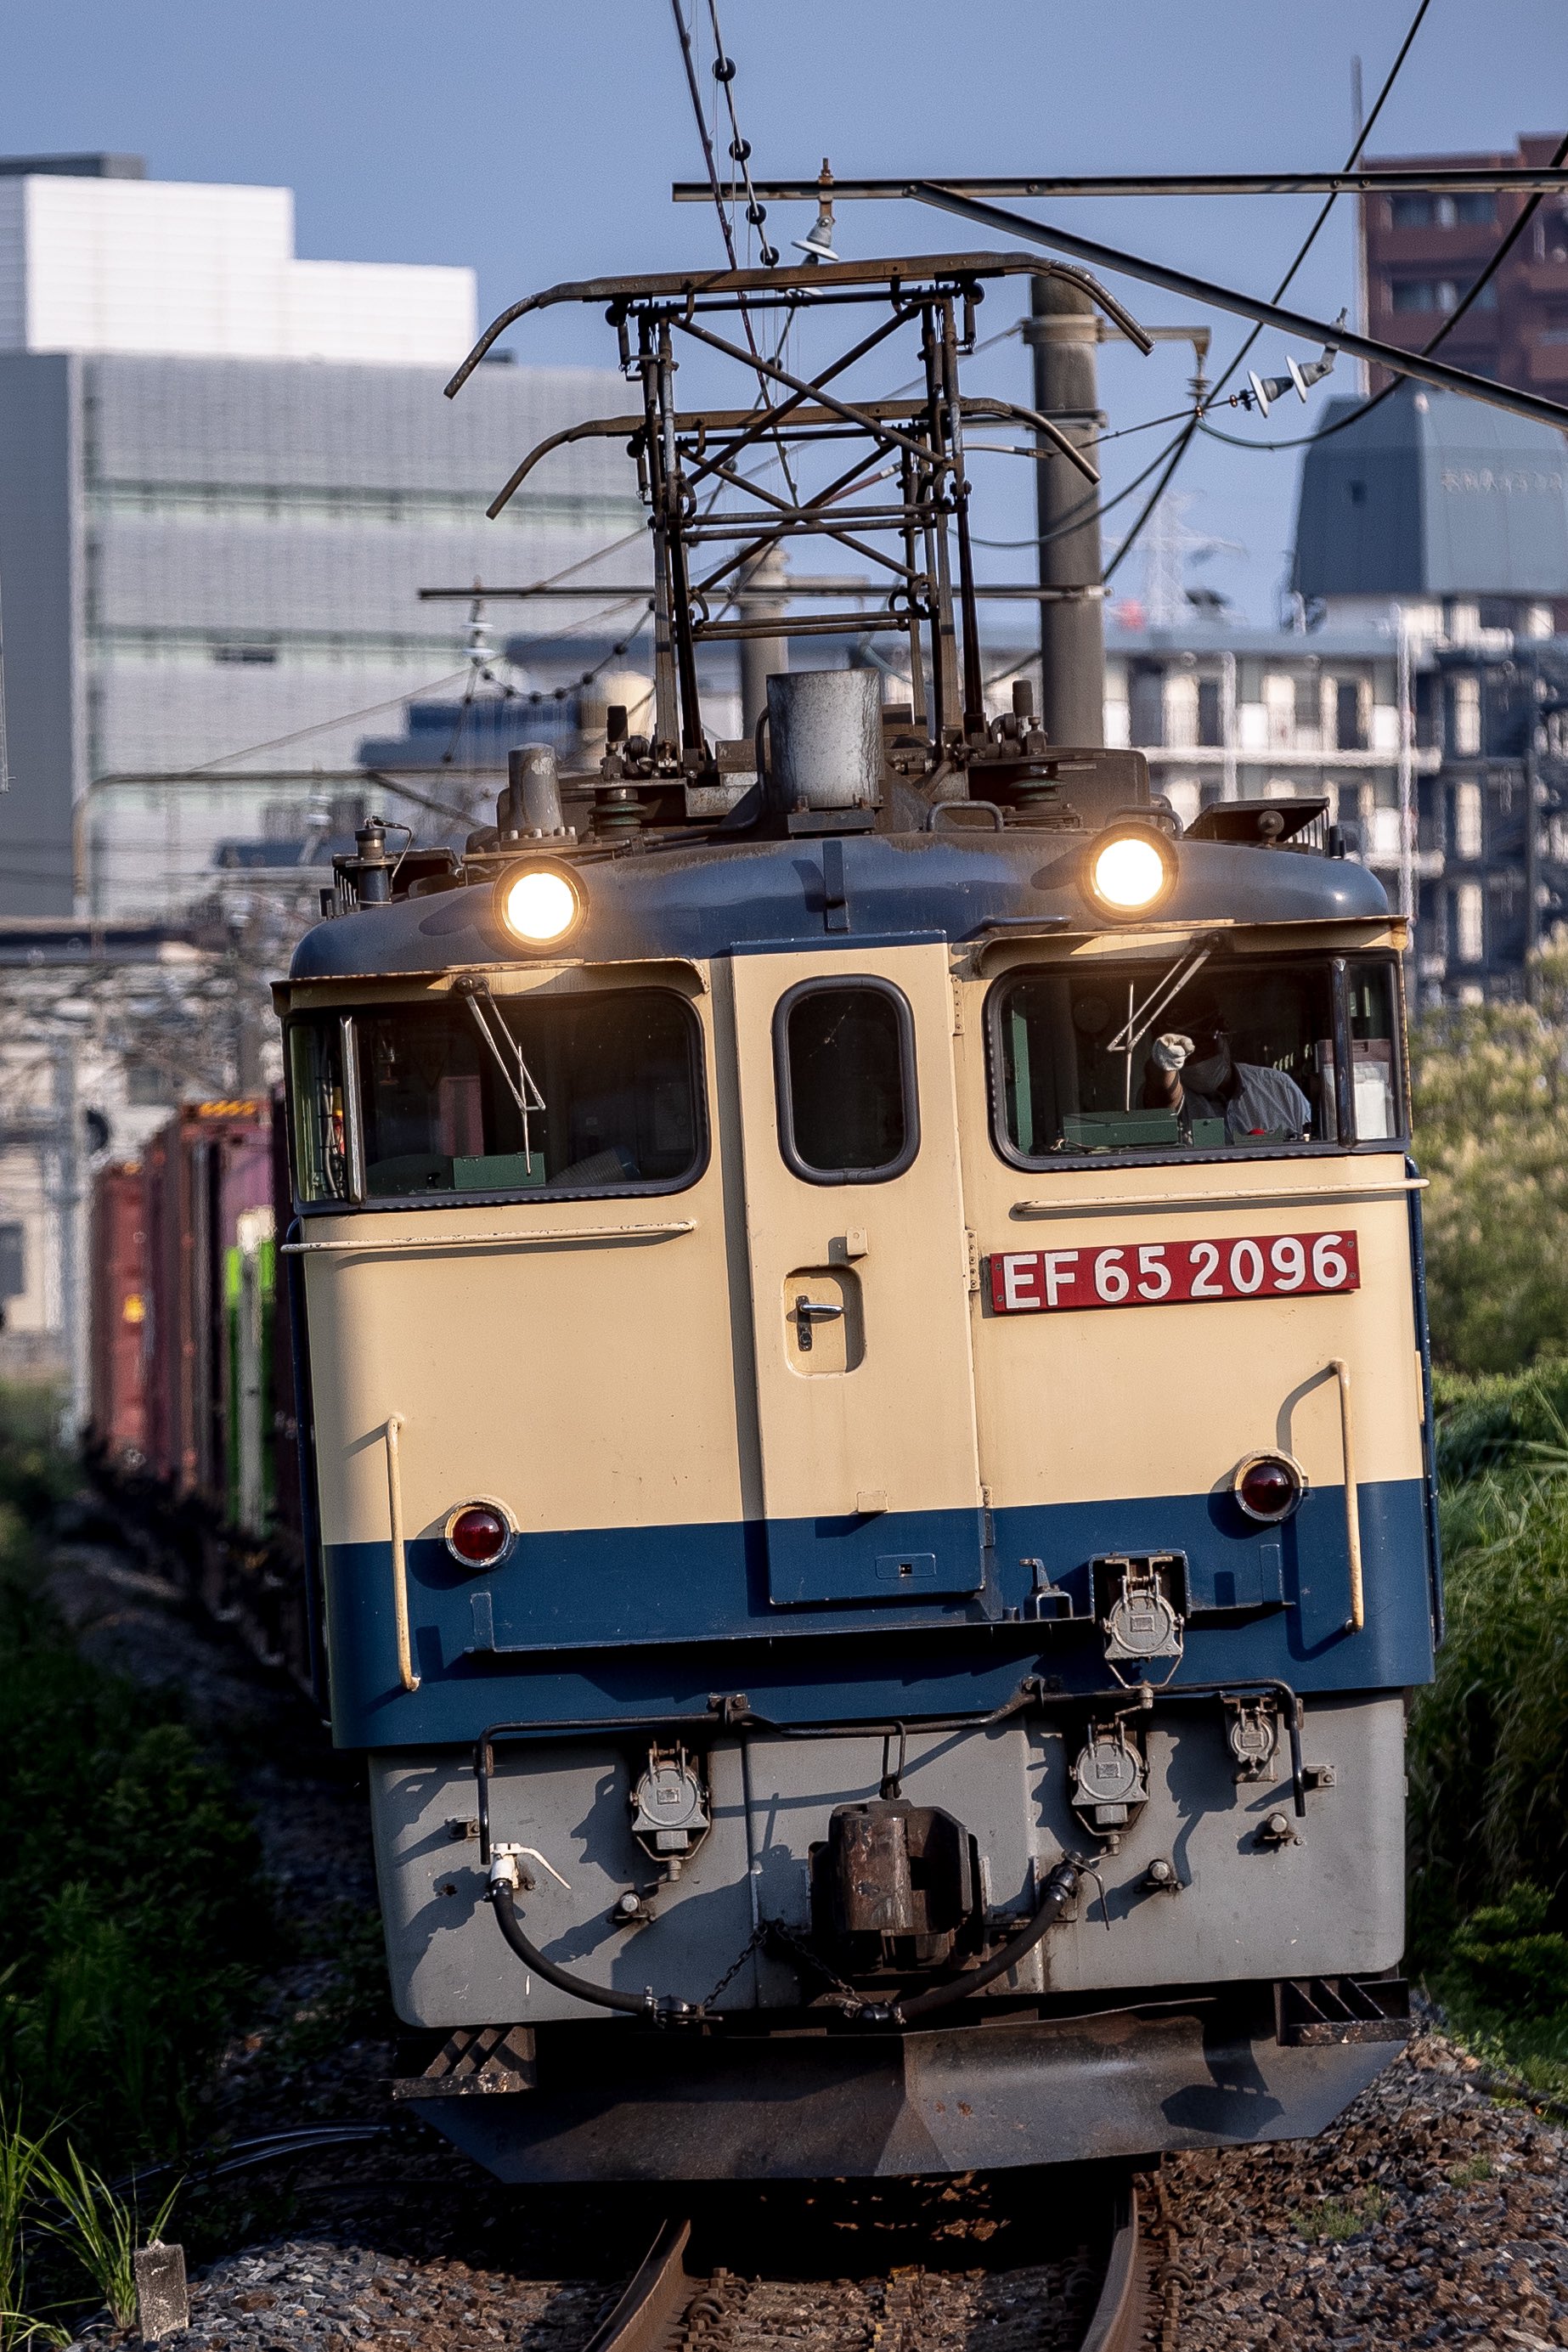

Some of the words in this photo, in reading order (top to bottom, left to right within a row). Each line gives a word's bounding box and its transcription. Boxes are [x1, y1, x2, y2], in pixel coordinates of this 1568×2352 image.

[1003, 1251, 1078, 1308] EF
[1094, 1246, 1172, 1302] 65
[1189, 1234, 1347, 1297] 2096
